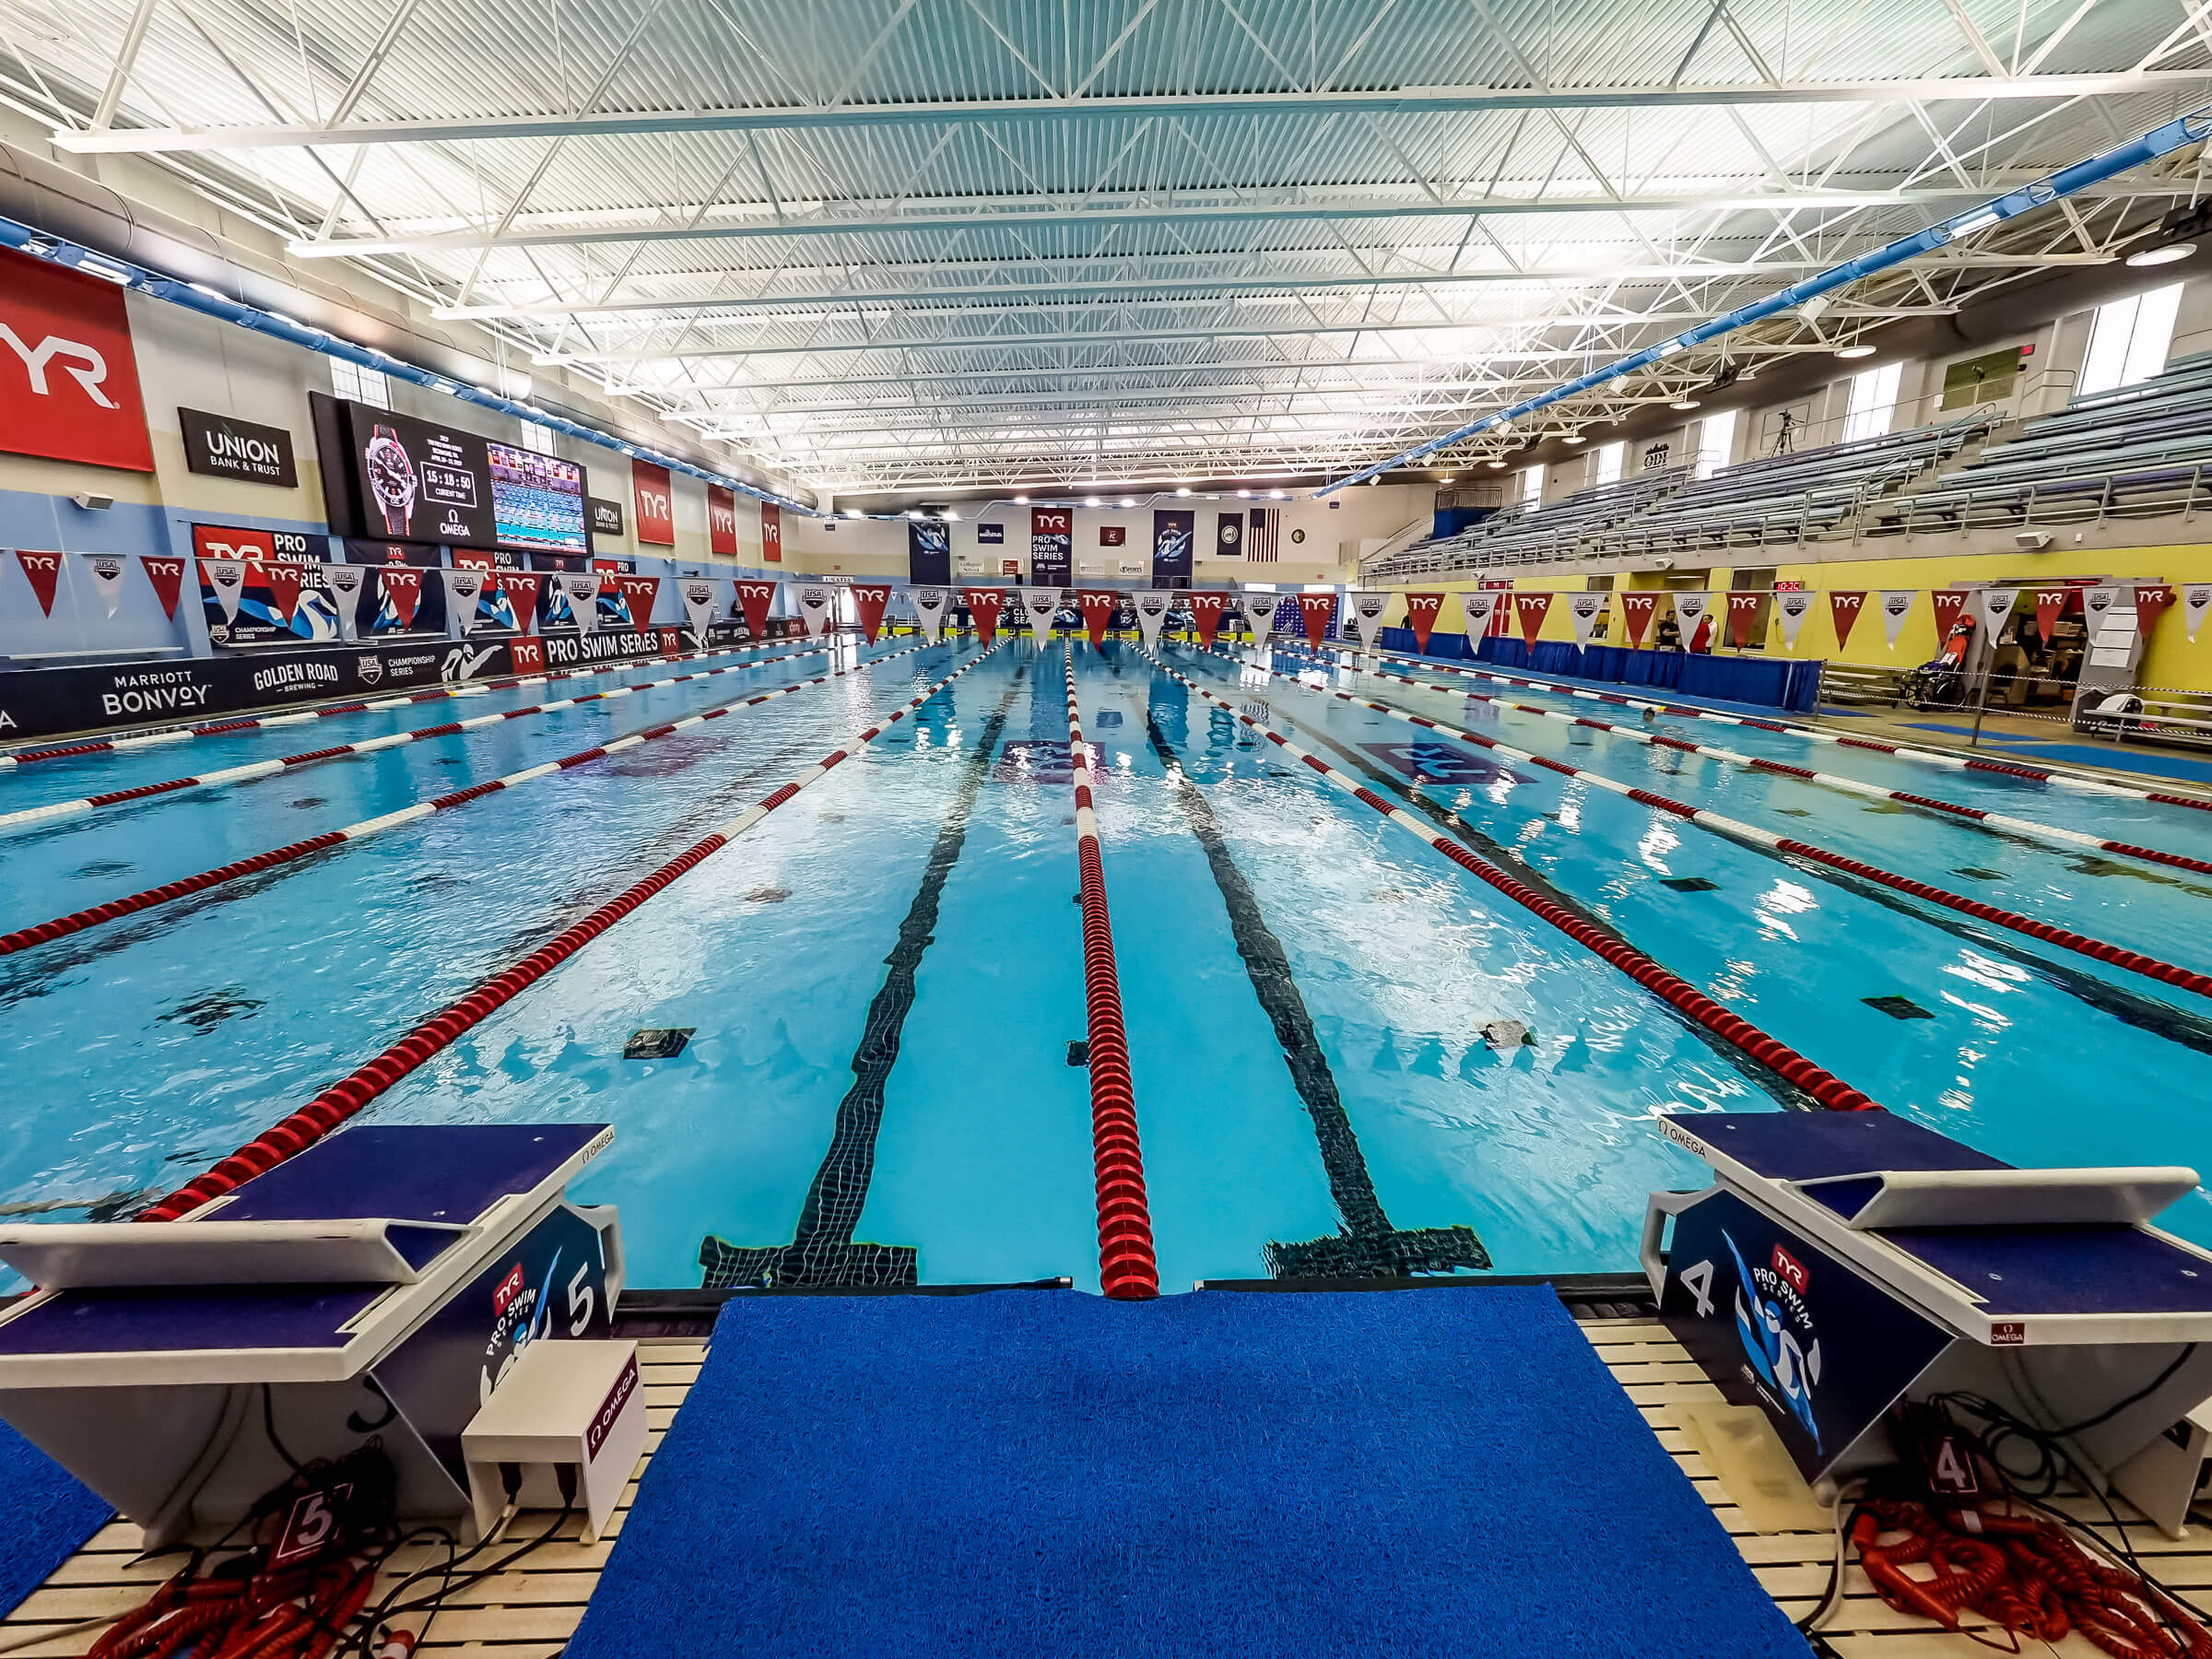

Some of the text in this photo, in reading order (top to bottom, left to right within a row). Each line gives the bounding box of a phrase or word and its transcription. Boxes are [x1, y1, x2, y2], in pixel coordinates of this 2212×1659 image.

[0, 322, 116, 409] YR
[206, 430, 280, 465] UNION
[209, 455, 280, 476] BANK & TRUST
[641, 489, 669, 521] TYR
[594, 505, 618, 524] UNION
[714, 509, 734, 534] TYR
[1037, 515, 1065, 528] TYR
[440, 523, 471, 536] OMEGA
[764, 523, 779, 544] TYR
[274, 534, 306, 552] PRO
[1032, 535, 1051, 544] PRO
[387, 547, 403, 557] TYR
[1032, 544, 1058, 552] SWIM
[206, 542, 264, 572] TYR
[277, 553, 322, 570] SWIM
[494, 552, 512, 564] PRO
[1032, 552, 1064, 560] SERIES
[23, 556, 56, 571] TYR
[99, 560, 115, 569] USA
[148, 562, 180, 576] TYR
[617, 562, 629, 571] PRO
[267, 568, 300, 582] TYR
[300, 572, 330, 588] RIES
[386, 573, 418, 586] TYR
[506, 578, 535, 591] TYR
[623, 582, 653, 594] TYR
[740, 585, 770, 598] TYR
[855, 589, 884, 602] TYR
[970, 593, 999, 606] TYR
[1082, 594, 1111, 607] TYR
[1194, 596, 1221, 609] TYR
[1731, 596, 1757, 609] TYR
[1834, 596, 1860, 608] TYR
[1936, 595, 1961, 606] TYR
[2037, 593, 2063, 605] TYR
[2138, 590, 2164, 603] TYR
[1302, 598, 1329, 611] TYR
[1411, 598, 1438, 610] TYR
[1520, 597, 1547, 610] TYR
[1626, 597, 1653, 610] TYR
[662, 633, 677, 647] TYR
[547, 632, 658, 663] PRO SWIM SERIES
[360, 657, 378, 667] USA
[388, 655, 436, 668] CHAMPIONSHIP
[514, 646, 539, 664] TYR
[253, 663, 339, 690] GOLDEN ROAD
[390, 667, 414, 677] SERIES
[114, 671, 192, 688] MARRIOTT
[284, 683, 316, 692] BREWING
[102, 685, 208, 715] BONVOY
[590, 1131, 615, 1156] OMEGA
[1670, 1128, 1706, 1159] OMEGA
[1777, 1251, 1802, 1286] TYR
[496, 1272, 520, 1305] TYR
[1680, 1259, 1714, 1319] 4
[568, 1261, 594, 1336] 5
[1753, 1267, 1814, 1330] PRO SWIM
[1762, 1283, 1801, 1323] SERIES
[486, 1288, 536, 1356] PRO SWIM
[1991, 1334, 2023, 1342] OMEGA
[602, 1369, 636, 1426] OMEGA
[1937, 1441, 1966, 1488] 4
[297, 1496, 332, 1546] 5
